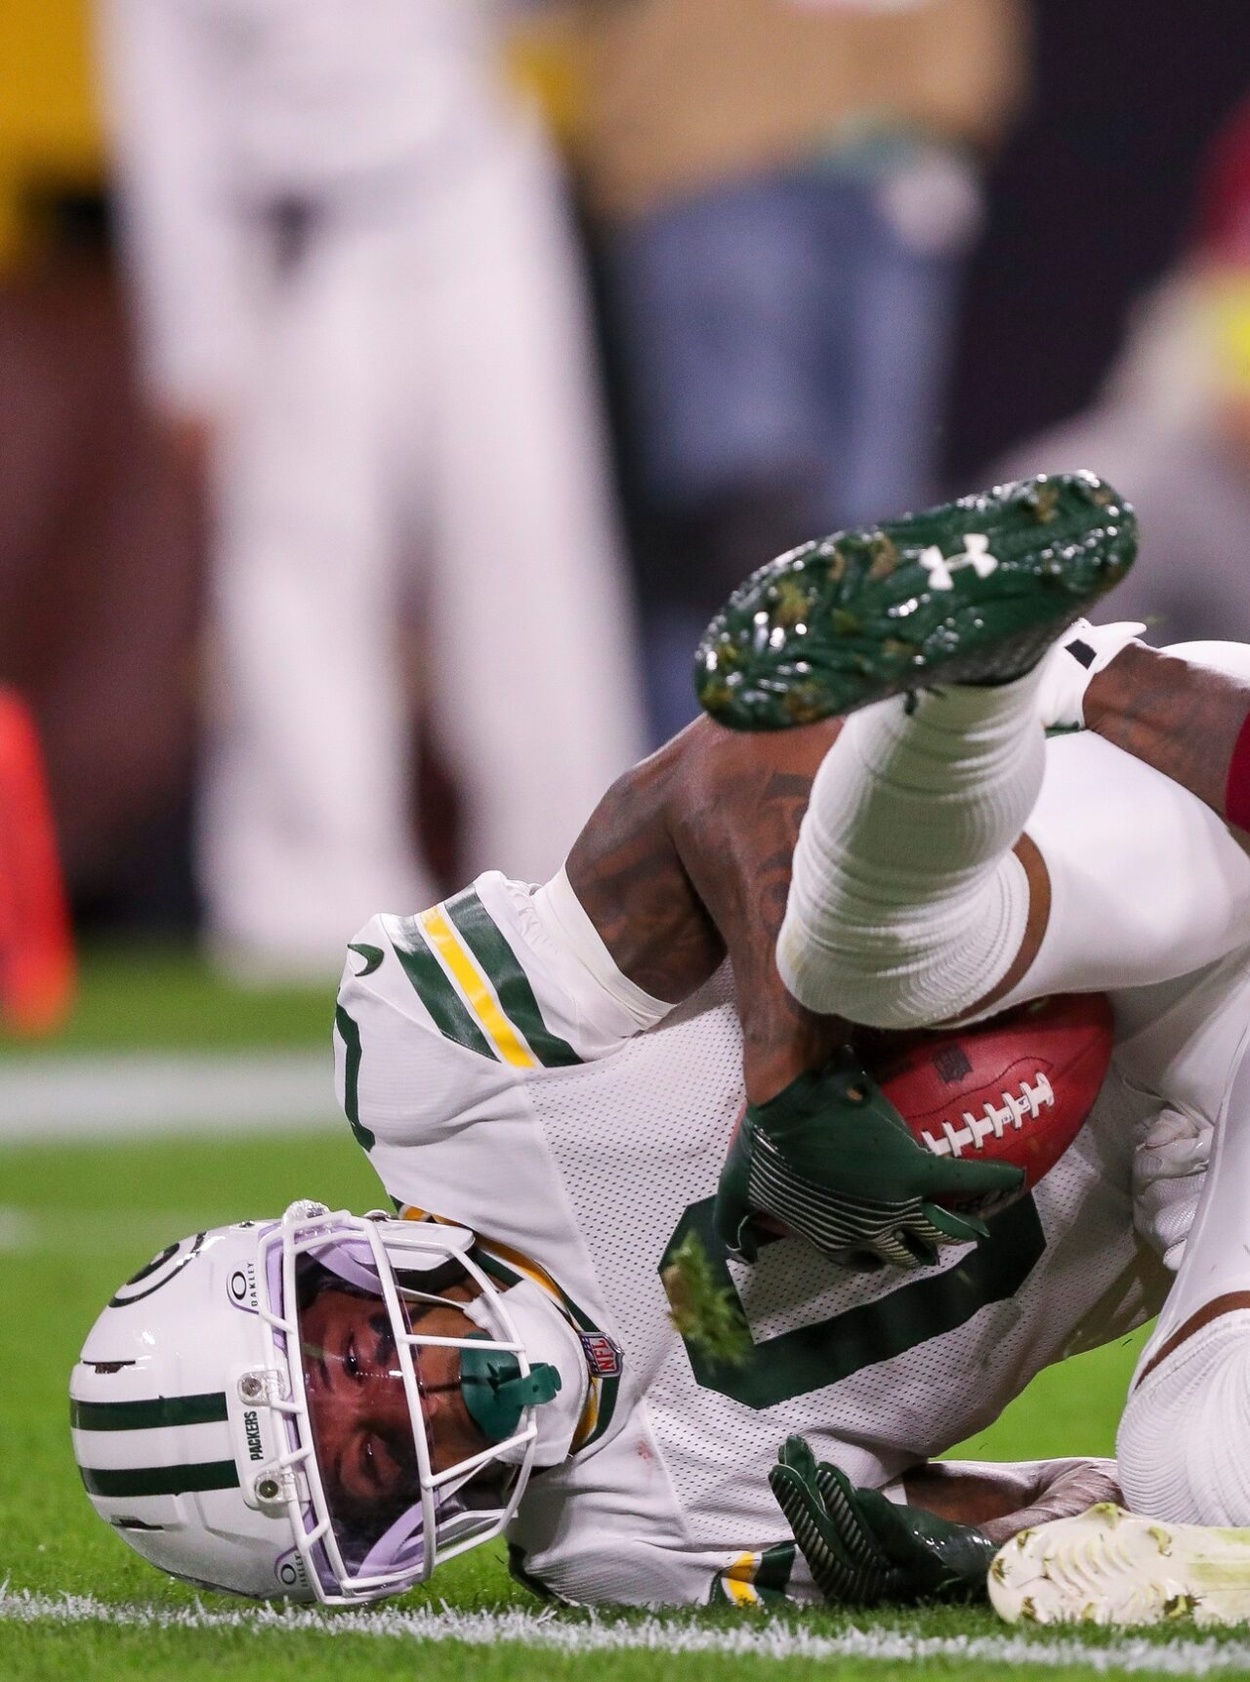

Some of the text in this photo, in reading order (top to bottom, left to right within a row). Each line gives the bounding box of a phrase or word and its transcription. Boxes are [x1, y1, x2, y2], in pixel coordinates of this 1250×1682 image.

[247, 1262, 259, 1307] OAKLEY
[592, 1339, 616, 1370] NFL
[244, 1410, 264, 1461] PACKERS
